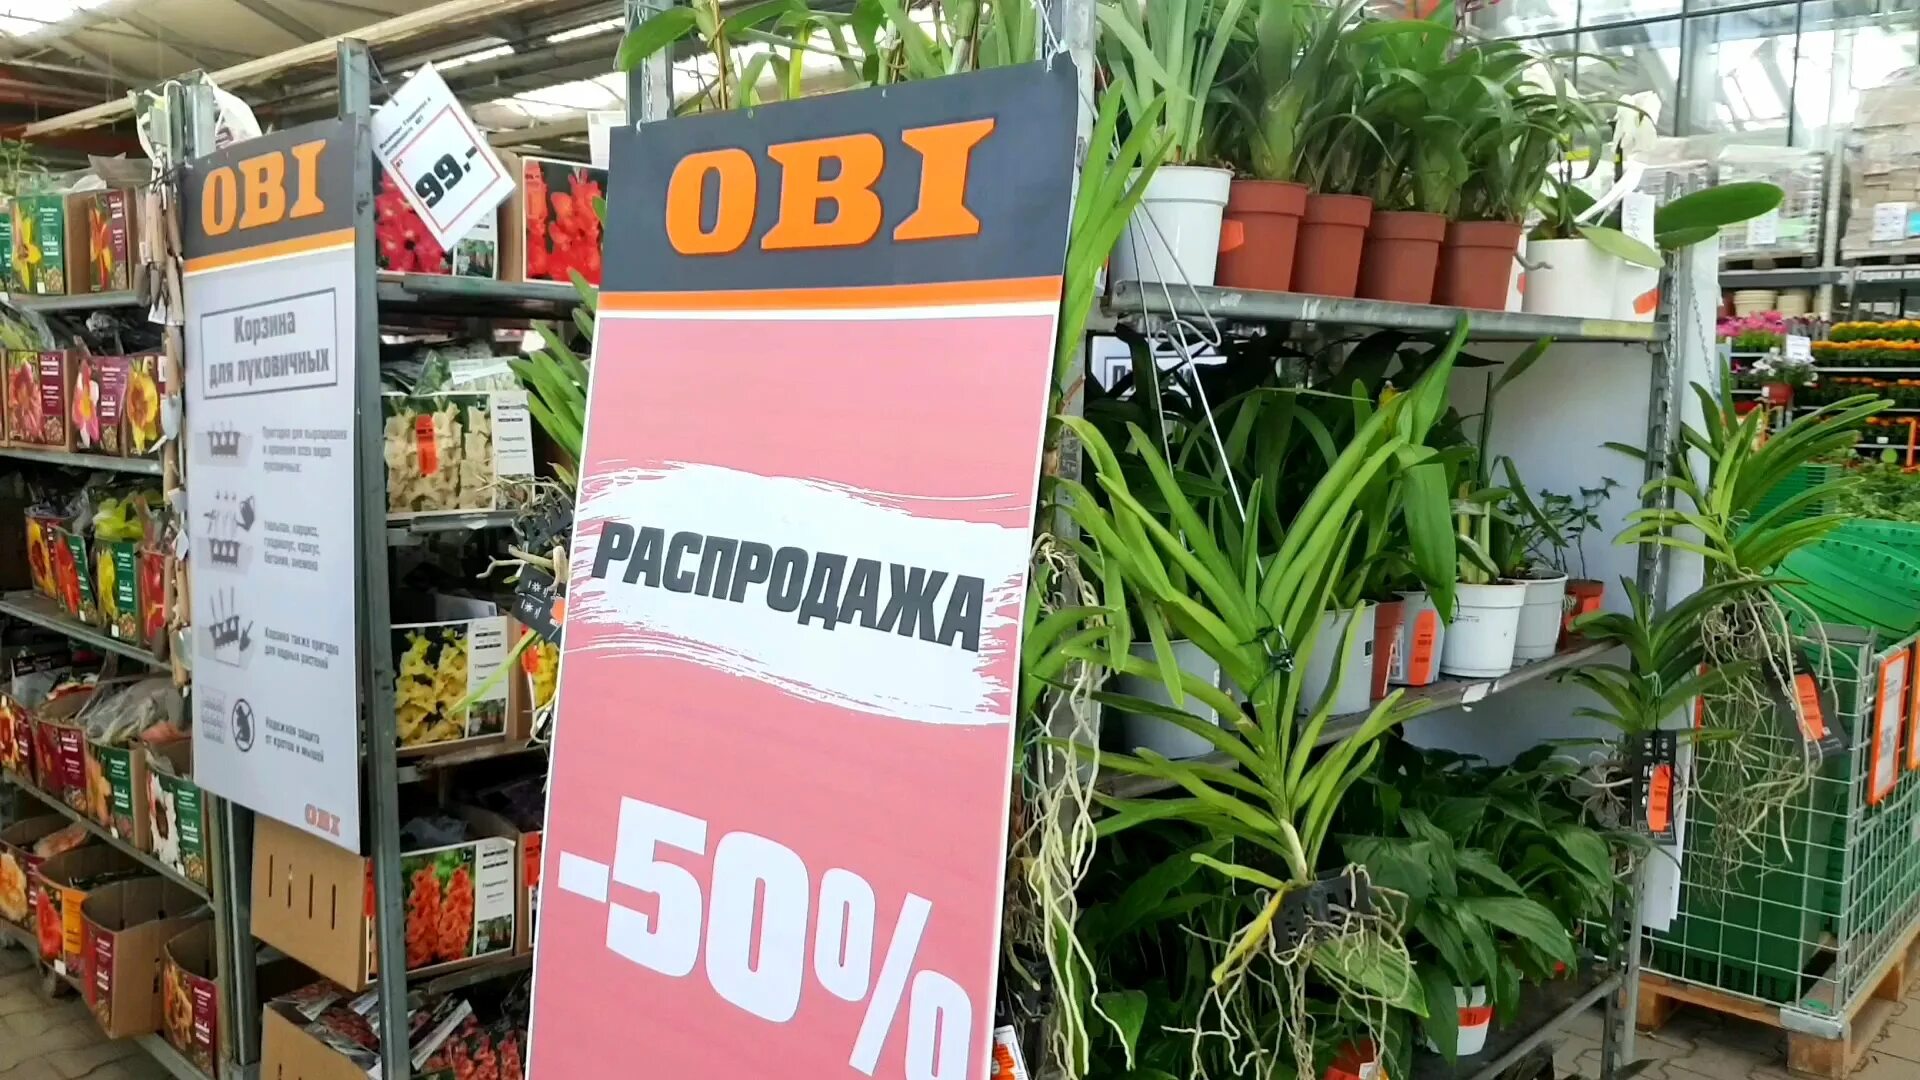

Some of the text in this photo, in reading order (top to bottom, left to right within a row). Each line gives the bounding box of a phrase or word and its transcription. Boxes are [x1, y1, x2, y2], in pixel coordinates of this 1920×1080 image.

[201, 139, 326, 237] OBI
[665, 118, 995, 255] OBI
[209, 347, 330, 389] для луковичных
[233, 311, 297, 346] Корзина
[591, 521, 986, 652] РАСПРОДАЖА
[557, 796, 972, 1080] -50%
